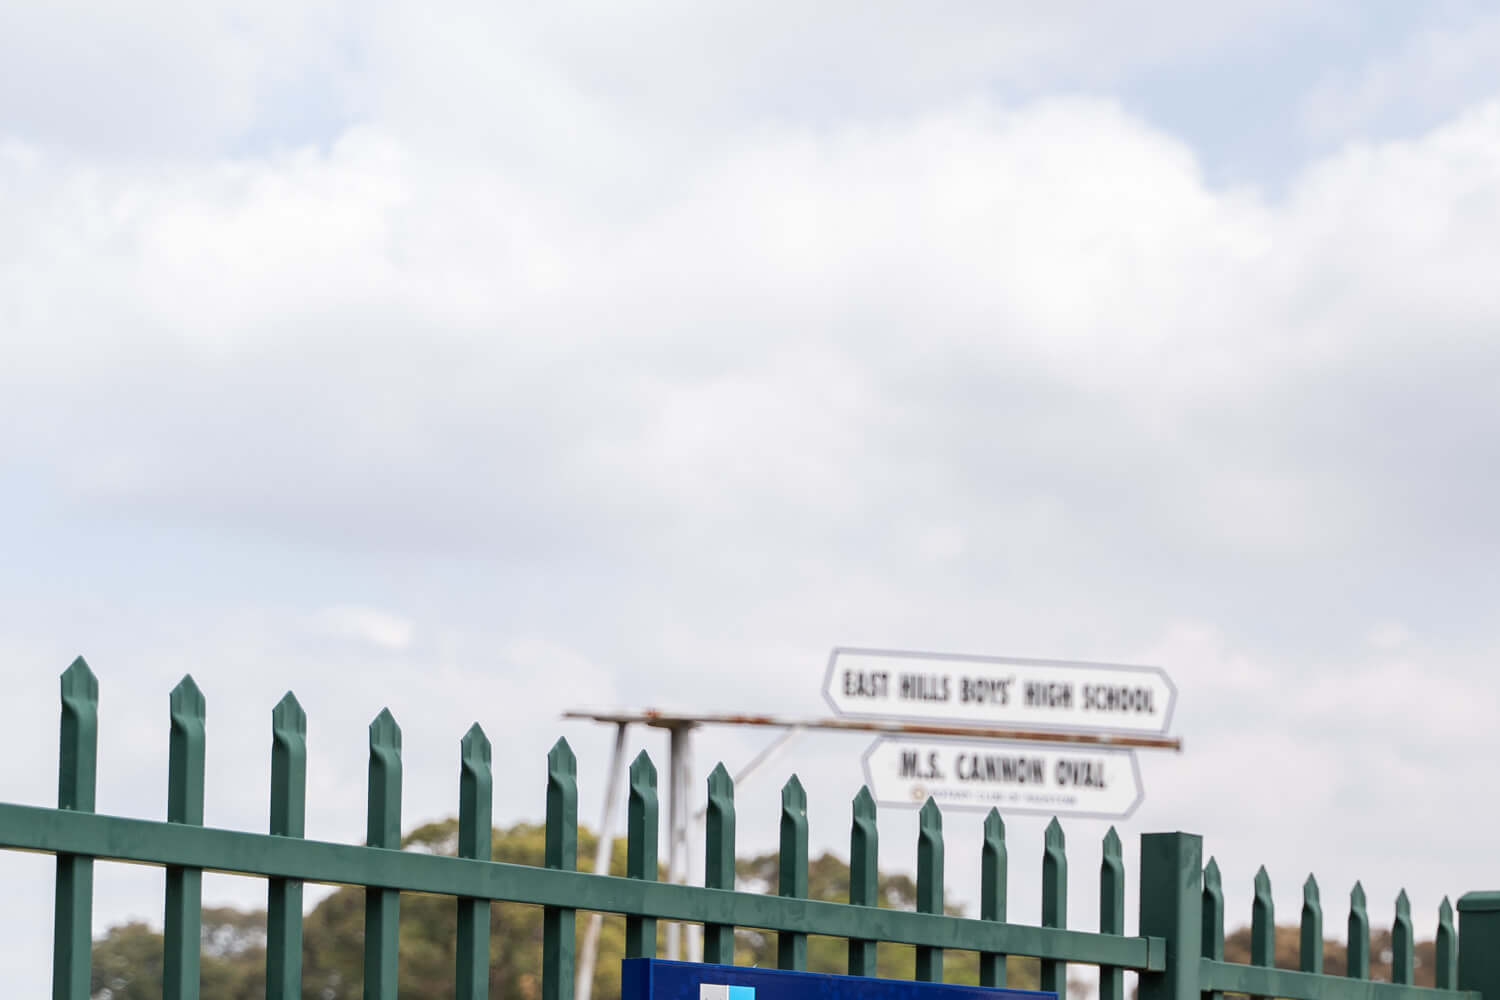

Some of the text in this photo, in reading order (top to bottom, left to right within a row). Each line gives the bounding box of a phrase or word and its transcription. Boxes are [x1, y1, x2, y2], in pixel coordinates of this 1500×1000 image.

[843, 669, 889, 698] EAST
[900, 672, 950, 703] HILLS
[1024, 680, 1074, 709] HIGH
[1082, 683, 1156, 715] SCHOOL
[954, 753, 1046, 787] CANNON
[1055, 757, 1108, 791] OVAL
